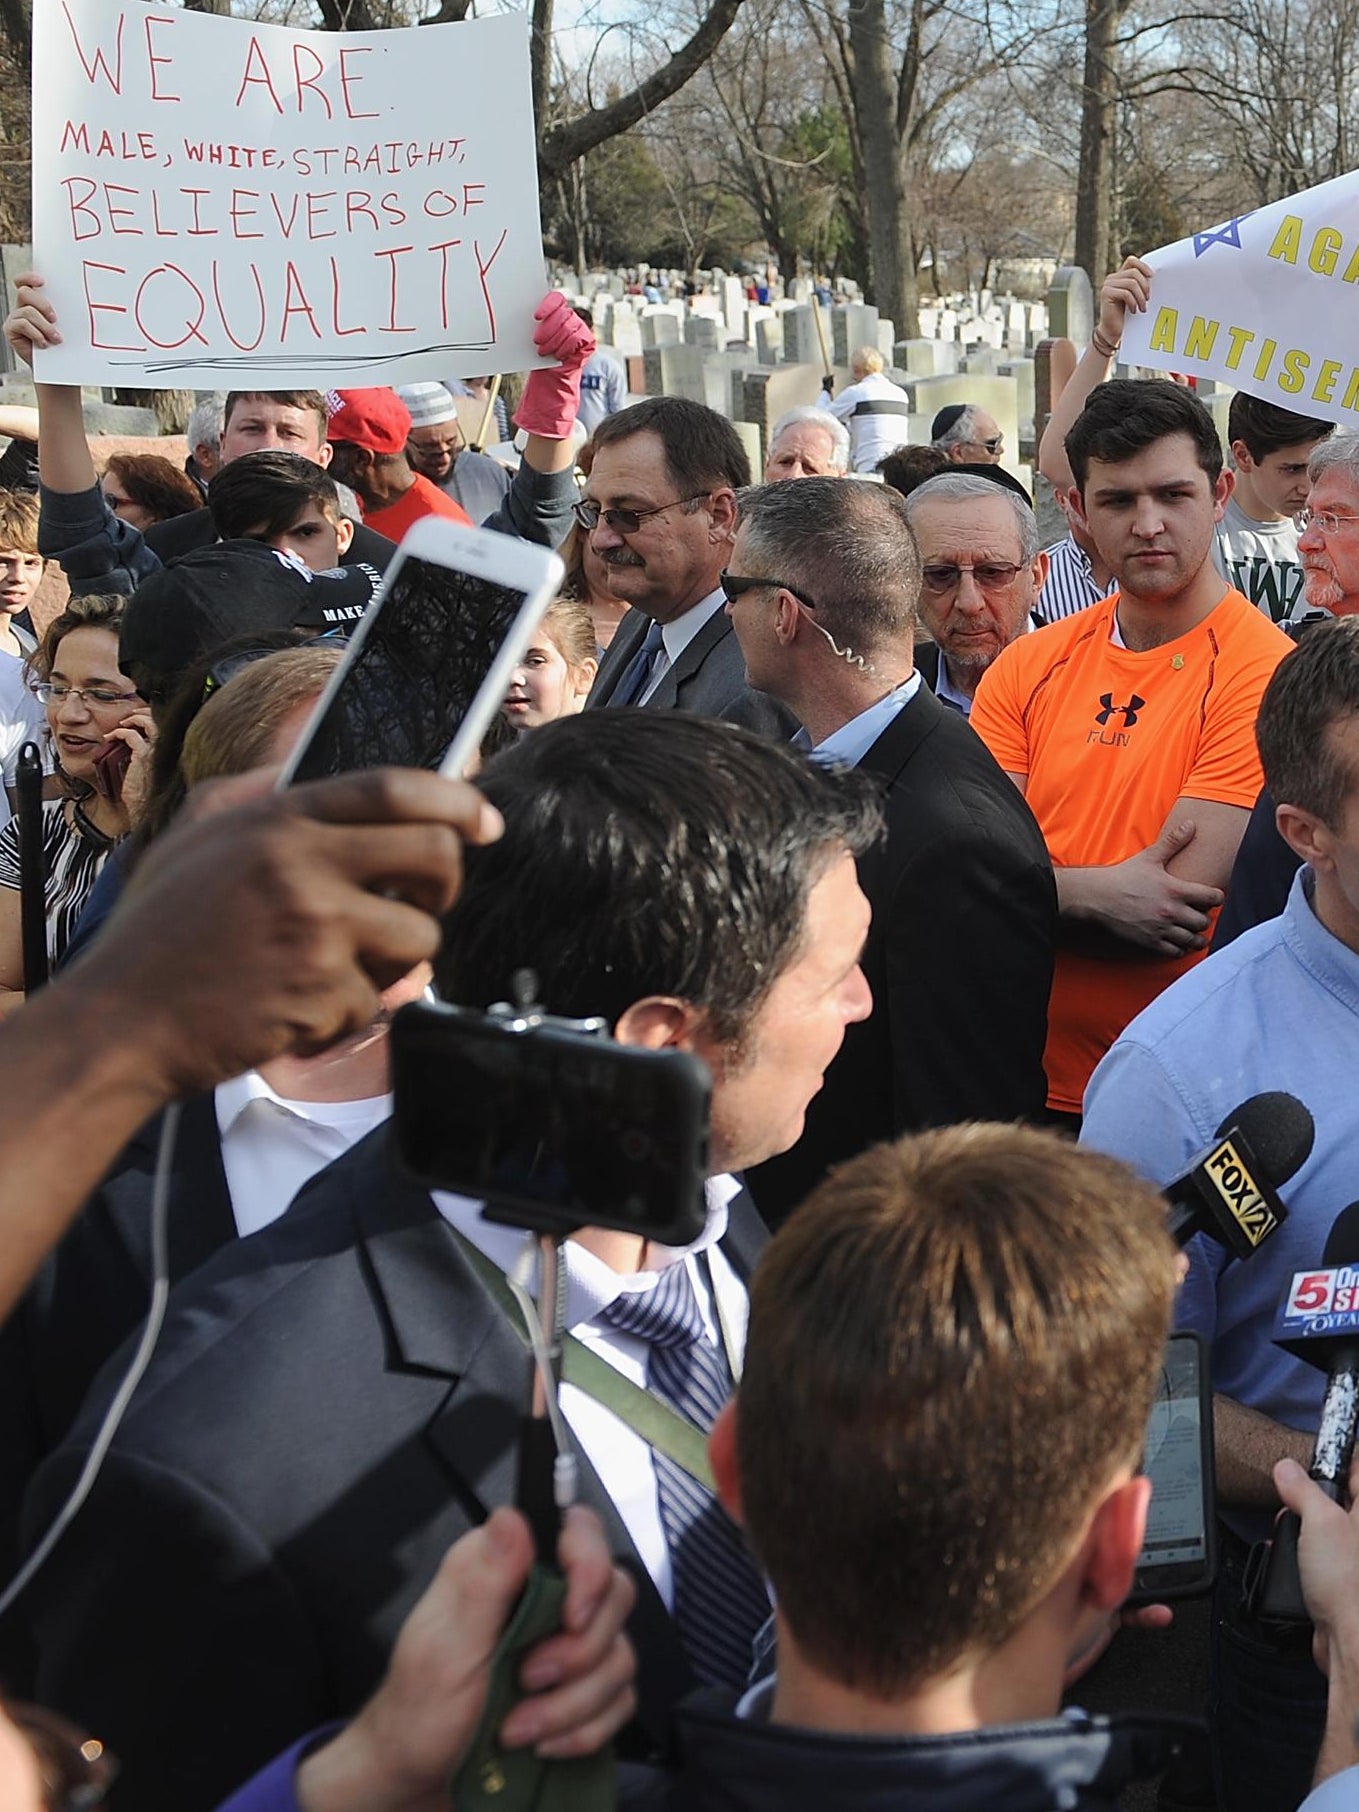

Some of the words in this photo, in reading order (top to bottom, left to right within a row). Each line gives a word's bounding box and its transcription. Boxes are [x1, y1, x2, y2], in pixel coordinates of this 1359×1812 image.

[62, 0, 180, 102] WE
[60, 120, 172, 168] MALE,
[184, 138, 285, 170] WHITE,
[292, 138, 466, 176] STRAIGHT,
[60, 176, 406, 241] BELIEVERS
[424, 184, 486, 218] OF
[82, 229, 508, 351] EQUALITY
[322, 604, 367, 622] MAKE
[1210, 1149, 1255, 1211] FOX
[1293, 1274, 1330, 1311] 5
